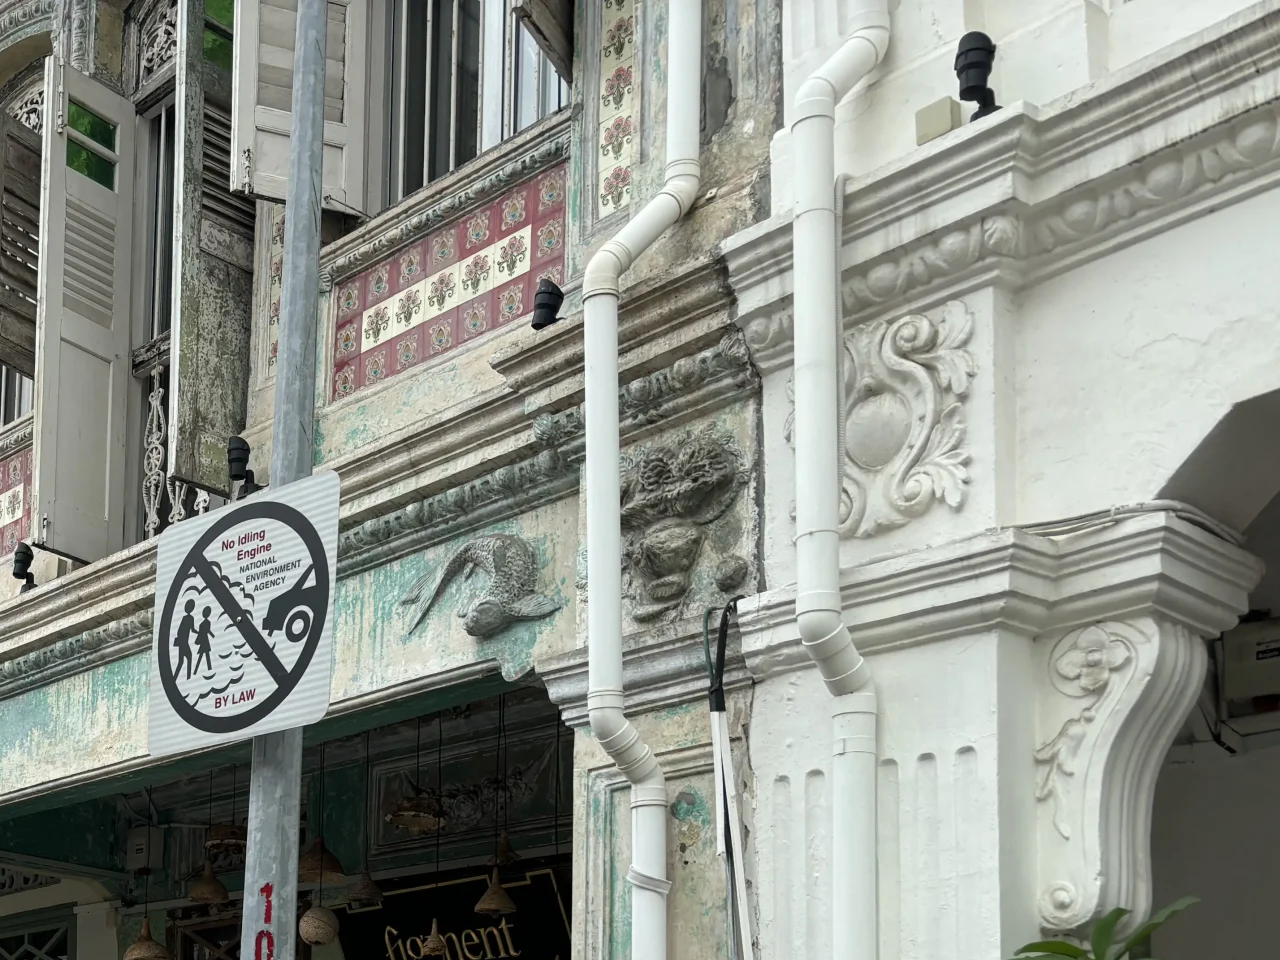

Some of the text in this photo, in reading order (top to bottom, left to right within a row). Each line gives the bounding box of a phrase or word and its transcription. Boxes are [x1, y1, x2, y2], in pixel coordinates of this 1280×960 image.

[221, 529, 266, 552] No Idling
[236, 541, 272, 562] Engine
[239, 555, 277, 574] NATIONAL
[245, 559, 302, 584] ENVIRONMENT
[253, 575, 287, 593] AGENCY
[214, 688, 256, 709] BY LAW
